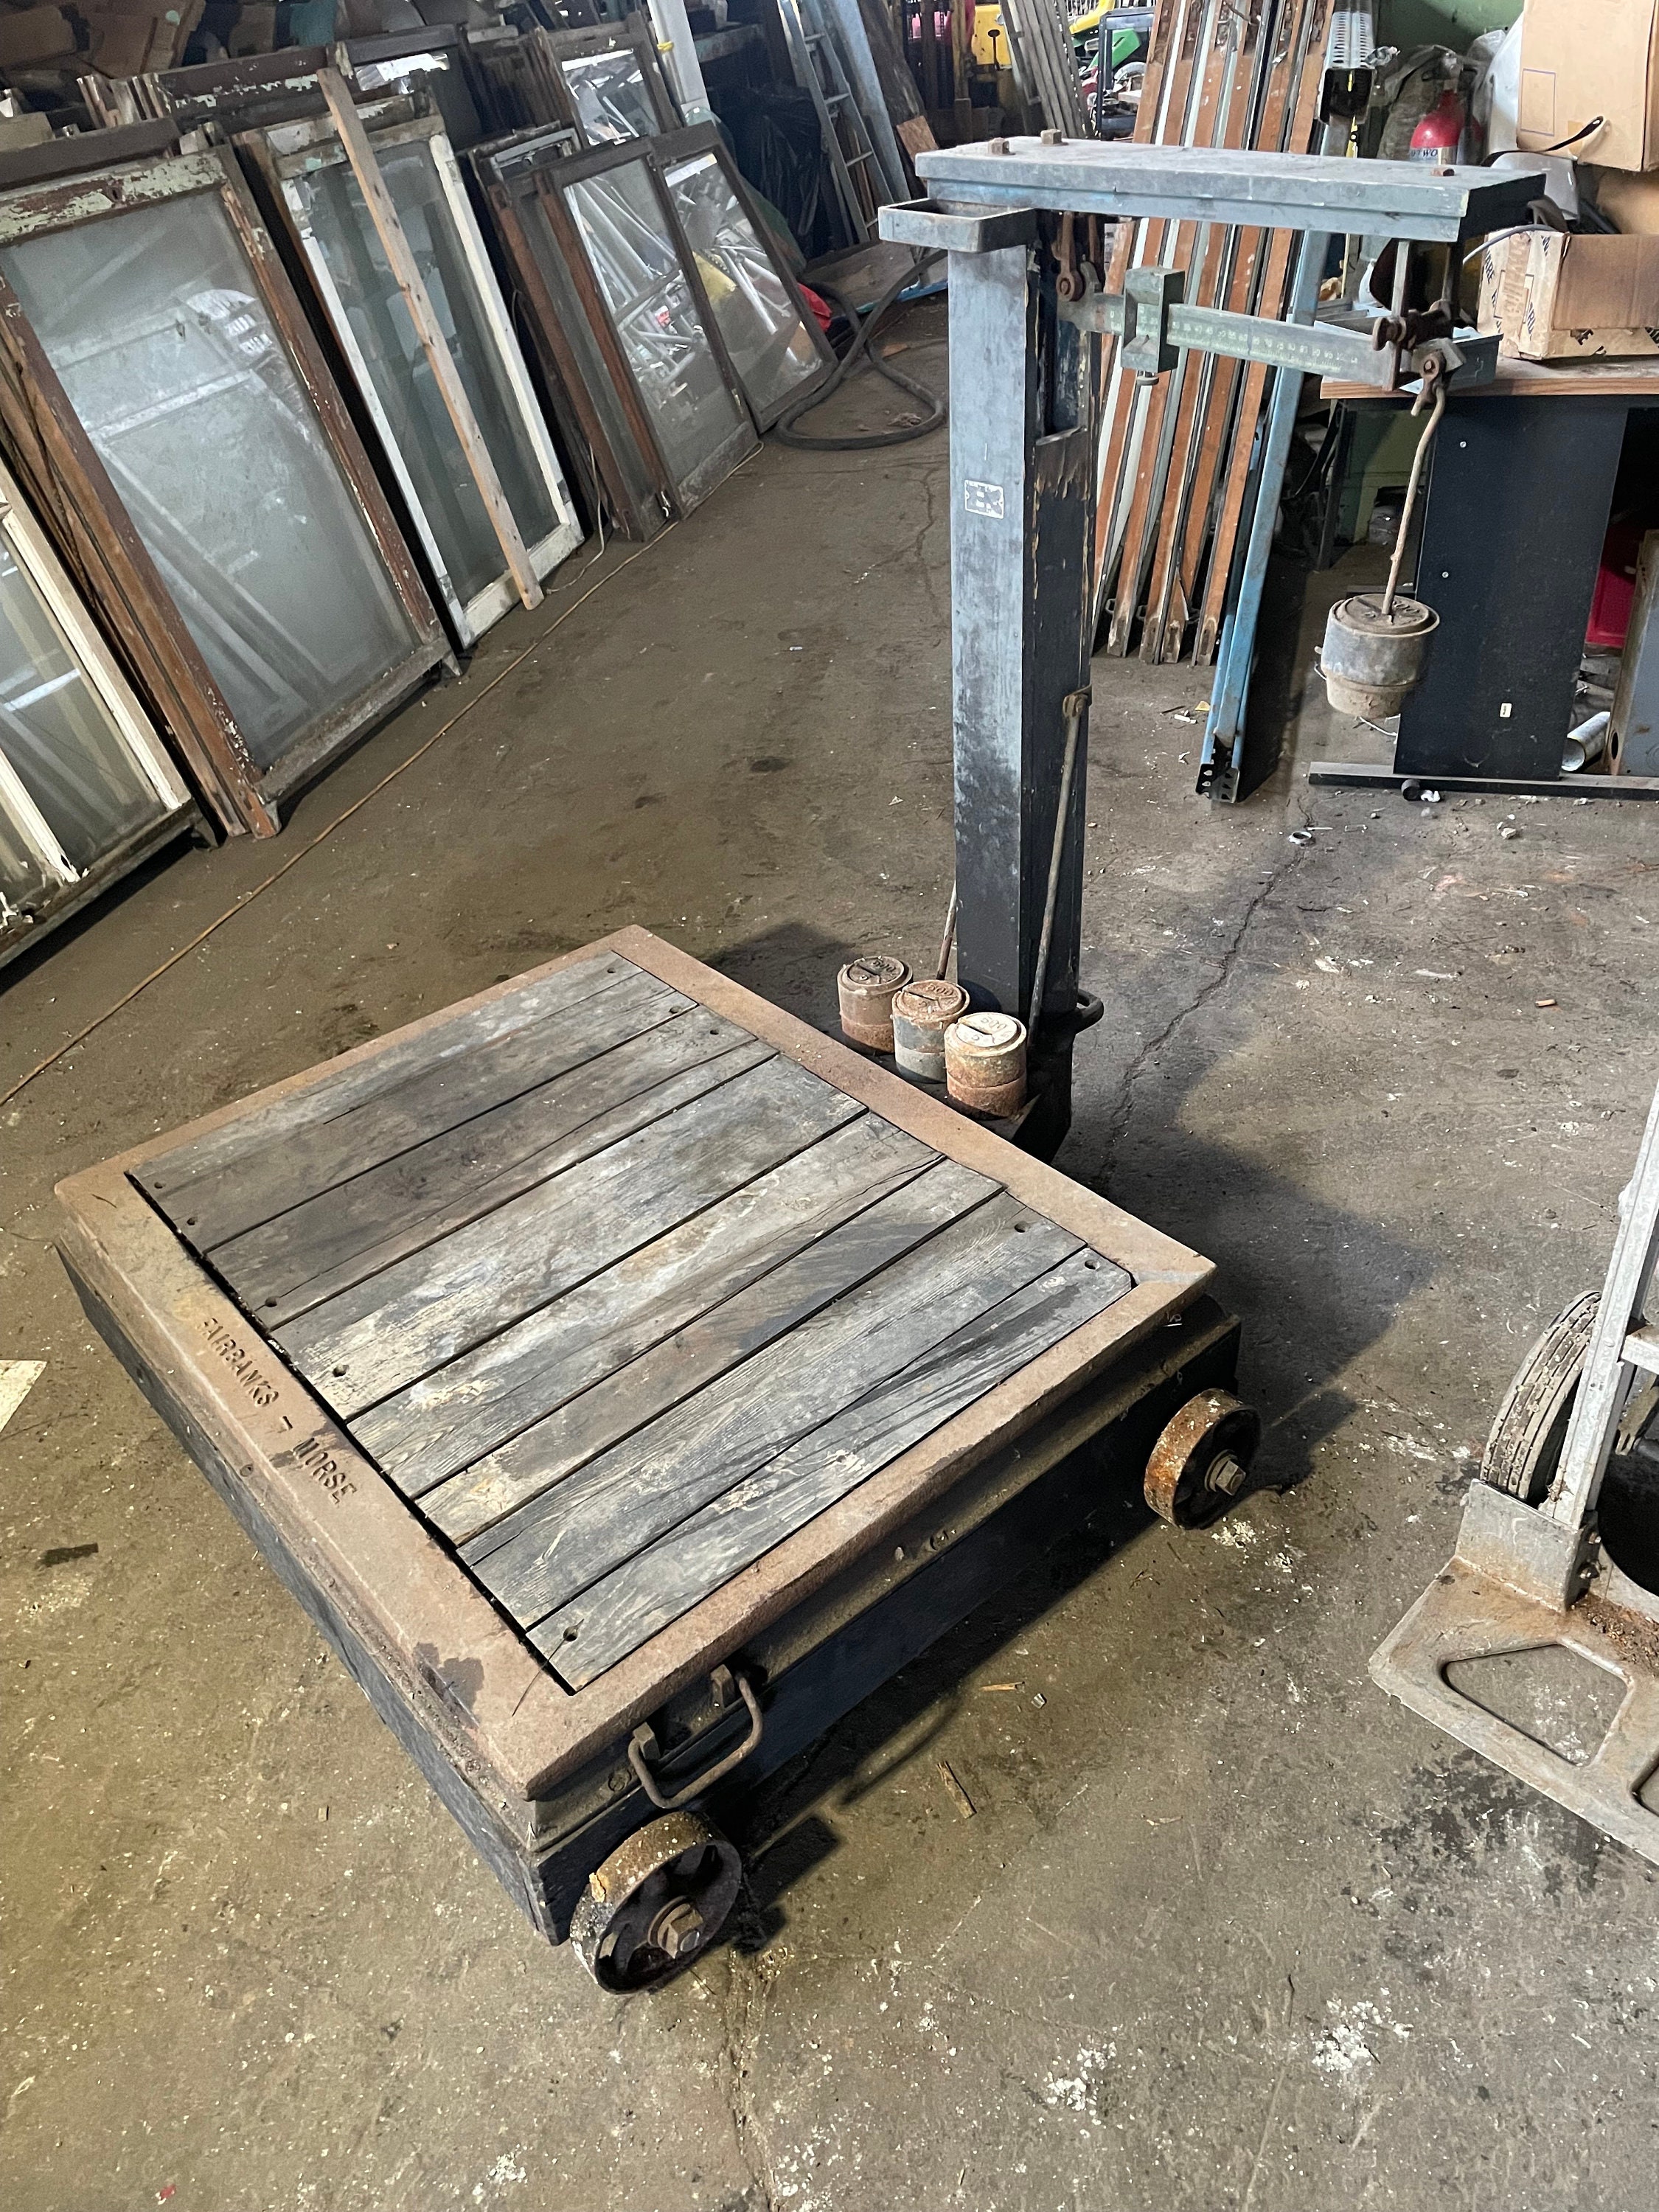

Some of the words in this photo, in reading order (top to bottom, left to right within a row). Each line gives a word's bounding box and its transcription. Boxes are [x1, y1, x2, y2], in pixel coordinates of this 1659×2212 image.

[980, 1017, 1007, 1032] 500
[198, 1317, 279, 1408] FAIRBANKS
[292, 1437, 358, 1506] MORSE
